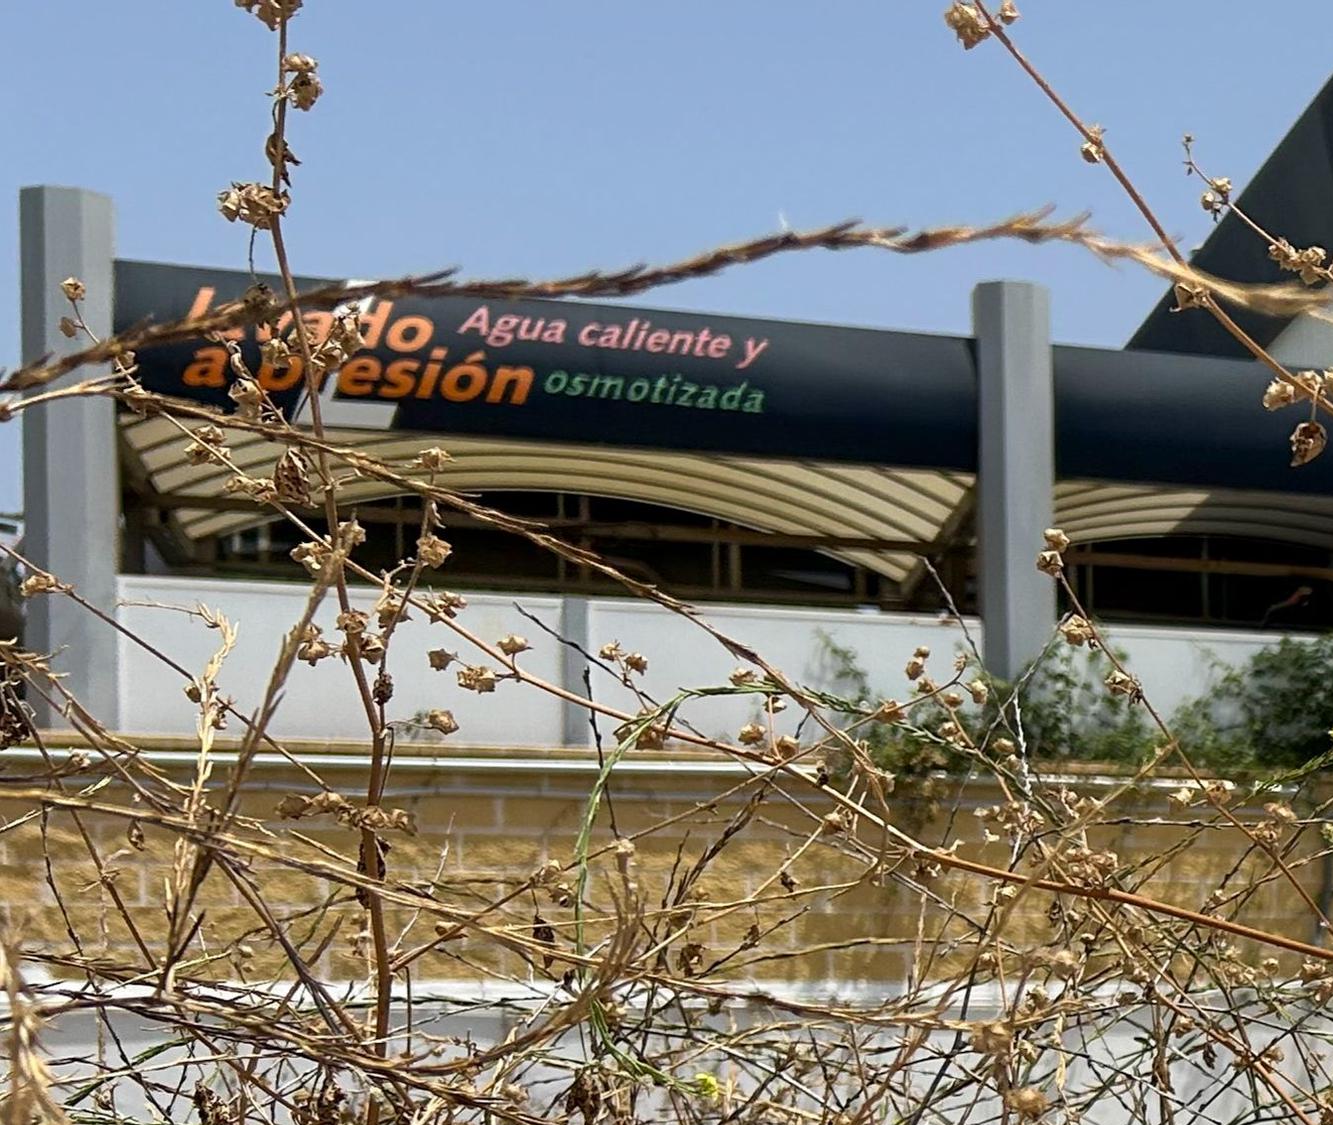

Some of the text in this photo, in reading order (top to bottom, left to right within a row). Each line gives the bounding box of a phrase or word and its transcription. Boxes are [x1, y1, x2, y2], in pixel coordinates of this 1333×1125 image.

[186, 286, 434, 353] lvado
[456, 304, 769, 369] Agua caliente y
[182, 345, 535, 405] a pesión
[543, 368, 766, 414] osmotizada
